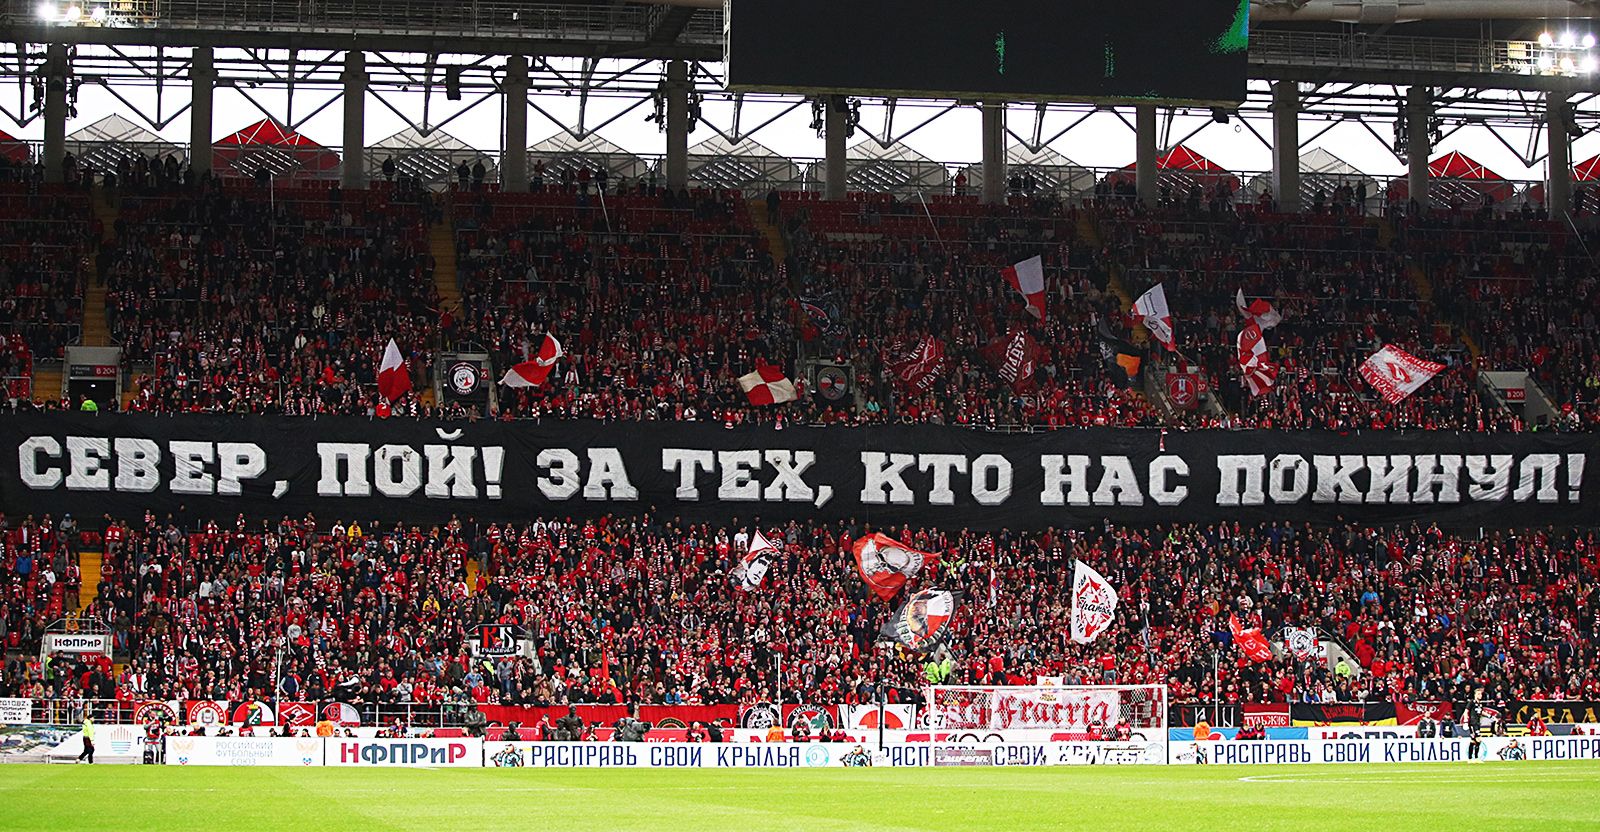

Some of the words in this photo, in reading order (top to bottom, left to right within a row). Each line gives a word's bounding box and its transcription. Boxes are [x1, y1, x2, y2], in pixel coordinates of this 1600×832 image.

[18, 436, 289, 499] СЕВЕР,
[317, 427, 504, 499] ПОЙ!
[536, 448, 640, 500] ЗА
[662, 448, 834, 509] ТЕХ,
[860, 451, 1013, 505] КТО
[1040, 454, 1190, 506] НАС
[1216, 453, 1586, 505] ПОКИНУЛ!
[54, 638, 102, 647] НФПРиР
[216, 741, 273, 749] РОССИЙСКИЙ
[340, 742, 467, 764] НФПРиР
[531, 745, 637, 767] РАСПРАВЬ
[650, 745, 702, 767] СВОИ
[717, 746, 800, 767] КРЫЛЬЯ
[1214, 743, 1311, 764] РАСПРАВЬ
[1324, 743, 1370, 763] СВОИ
[1384, 741, 1461, 762] КРЫЛЬЯ
[231, 758, 256, 766] СОЮЗ
